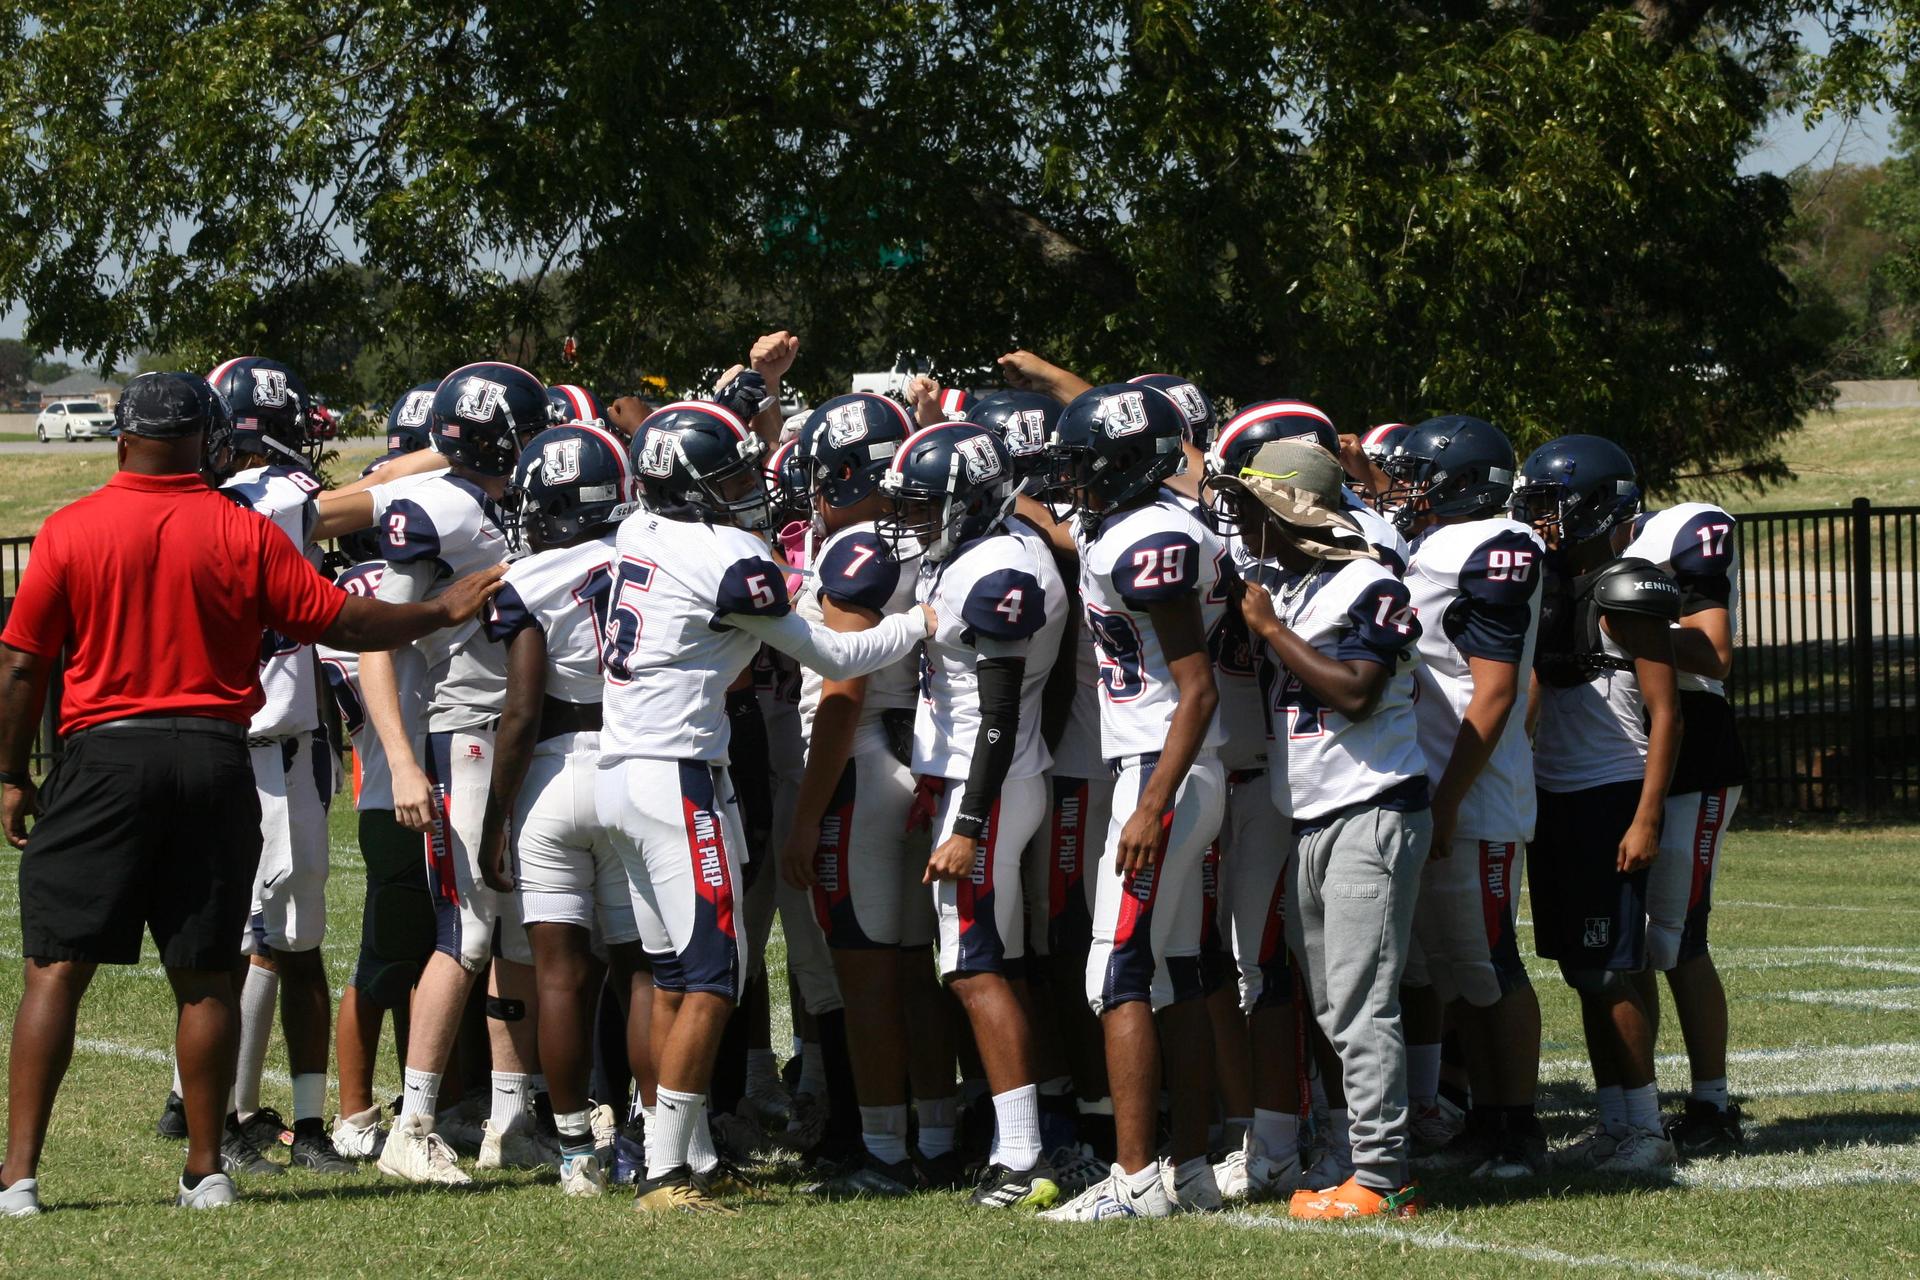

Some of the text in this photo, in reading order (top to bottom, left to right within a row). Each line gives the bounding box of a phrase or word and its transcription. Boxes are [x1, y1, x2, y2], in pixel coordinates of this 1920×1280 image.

[483, 387, 498, 417] UME PREP
[1133, 411, 1143, 424] UME
[661, 438, 673, 471] UME PREP
[980, 439, 999, 469] UME PREP
[1032, 431, 1041, 445] UME
[567, 460, 576, 473] UME
[389, 514, 407, 546] 3
[1696, 524, 1729, 557] 17
[843, 545, 875, 577] 7
[1134, 545, 1187, 588] 29
[1487, 550, 1532, 582] 95
[746, 574, 776, 609] 5
[1633, 581, 1679, 596] XENITH
[603, 554, 658, 686] 5
[997, 589, 1023, 623] 4
[1375, 596, 1412, 635] 14
[693, 810, 723, 887] UME PREP
[1058, 797, 1080, 873] UME PREP
[1699, 830, 1713, 865] PREP
[818, 816, 841, 892] UME PREP
[1488, 863, 1505, 898] PREP
